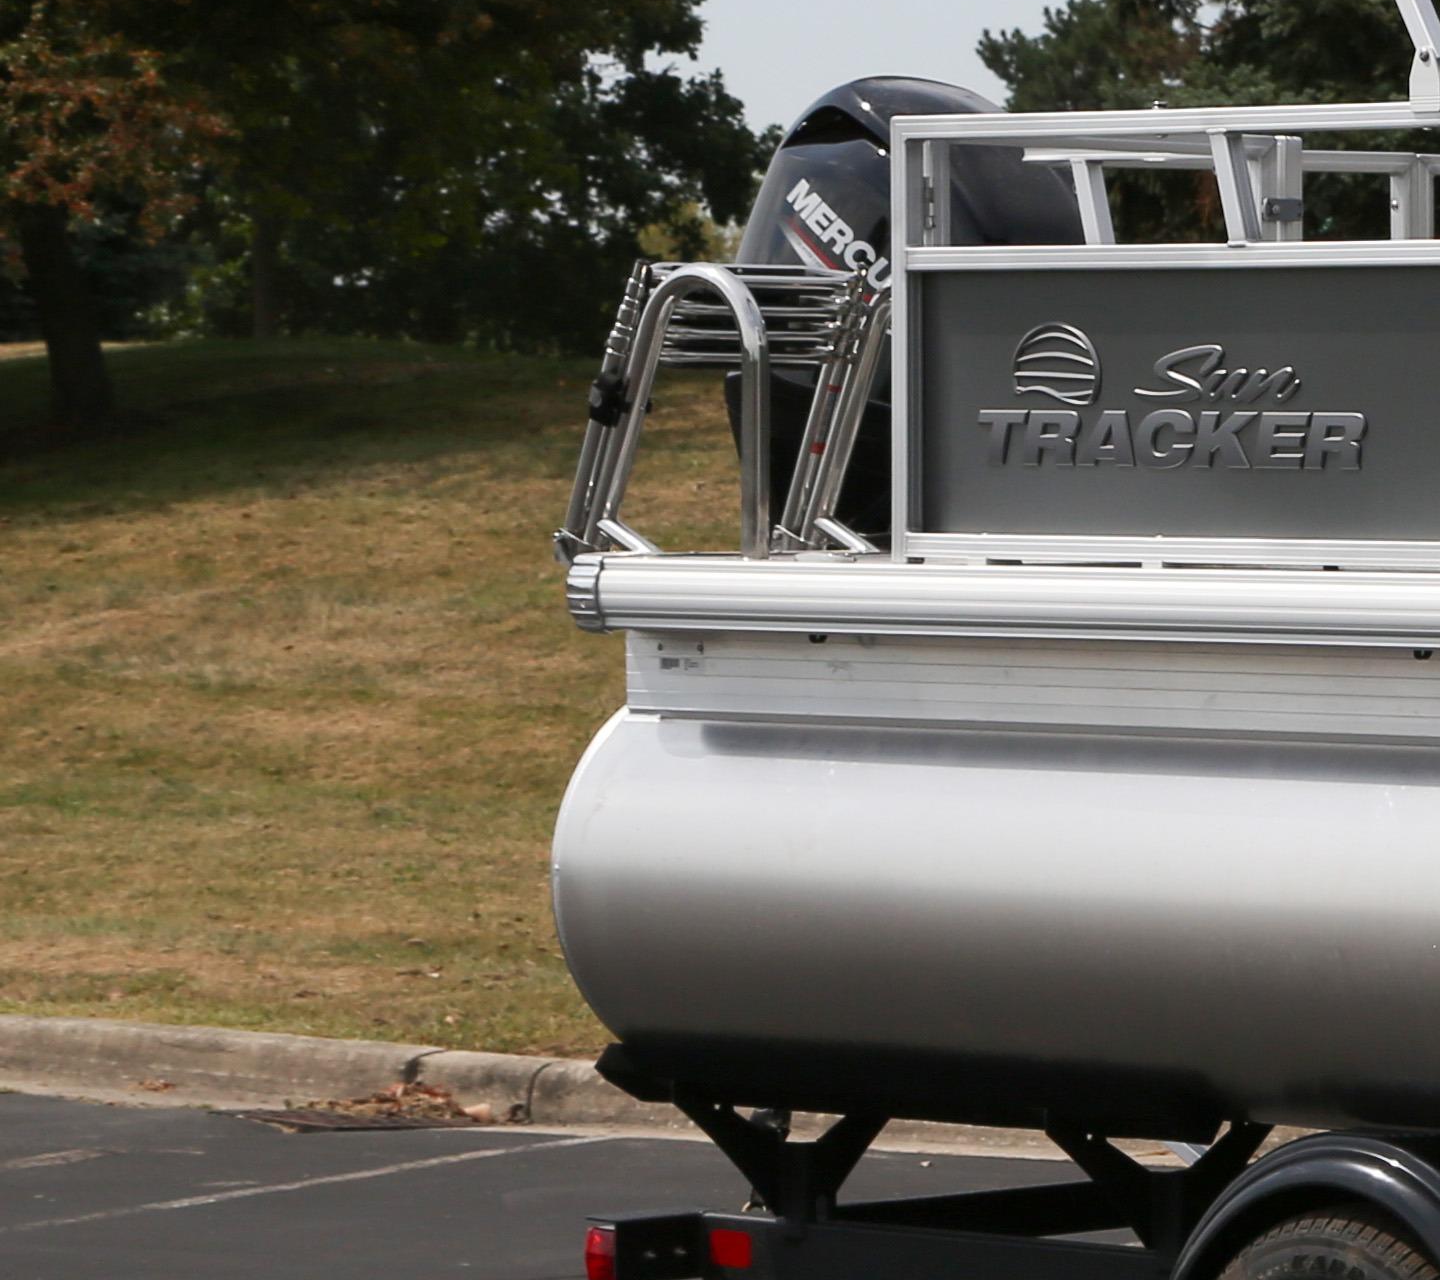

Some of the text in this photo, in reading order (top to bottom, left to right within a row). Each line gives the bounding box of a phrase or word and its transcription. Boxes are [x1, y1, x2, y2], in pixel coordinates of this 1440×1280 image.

[786, 178, 892, 290] MERCU
[1134, 344, 1300, 404] Sun
[977, 408, 1367, 470] TRACKER
